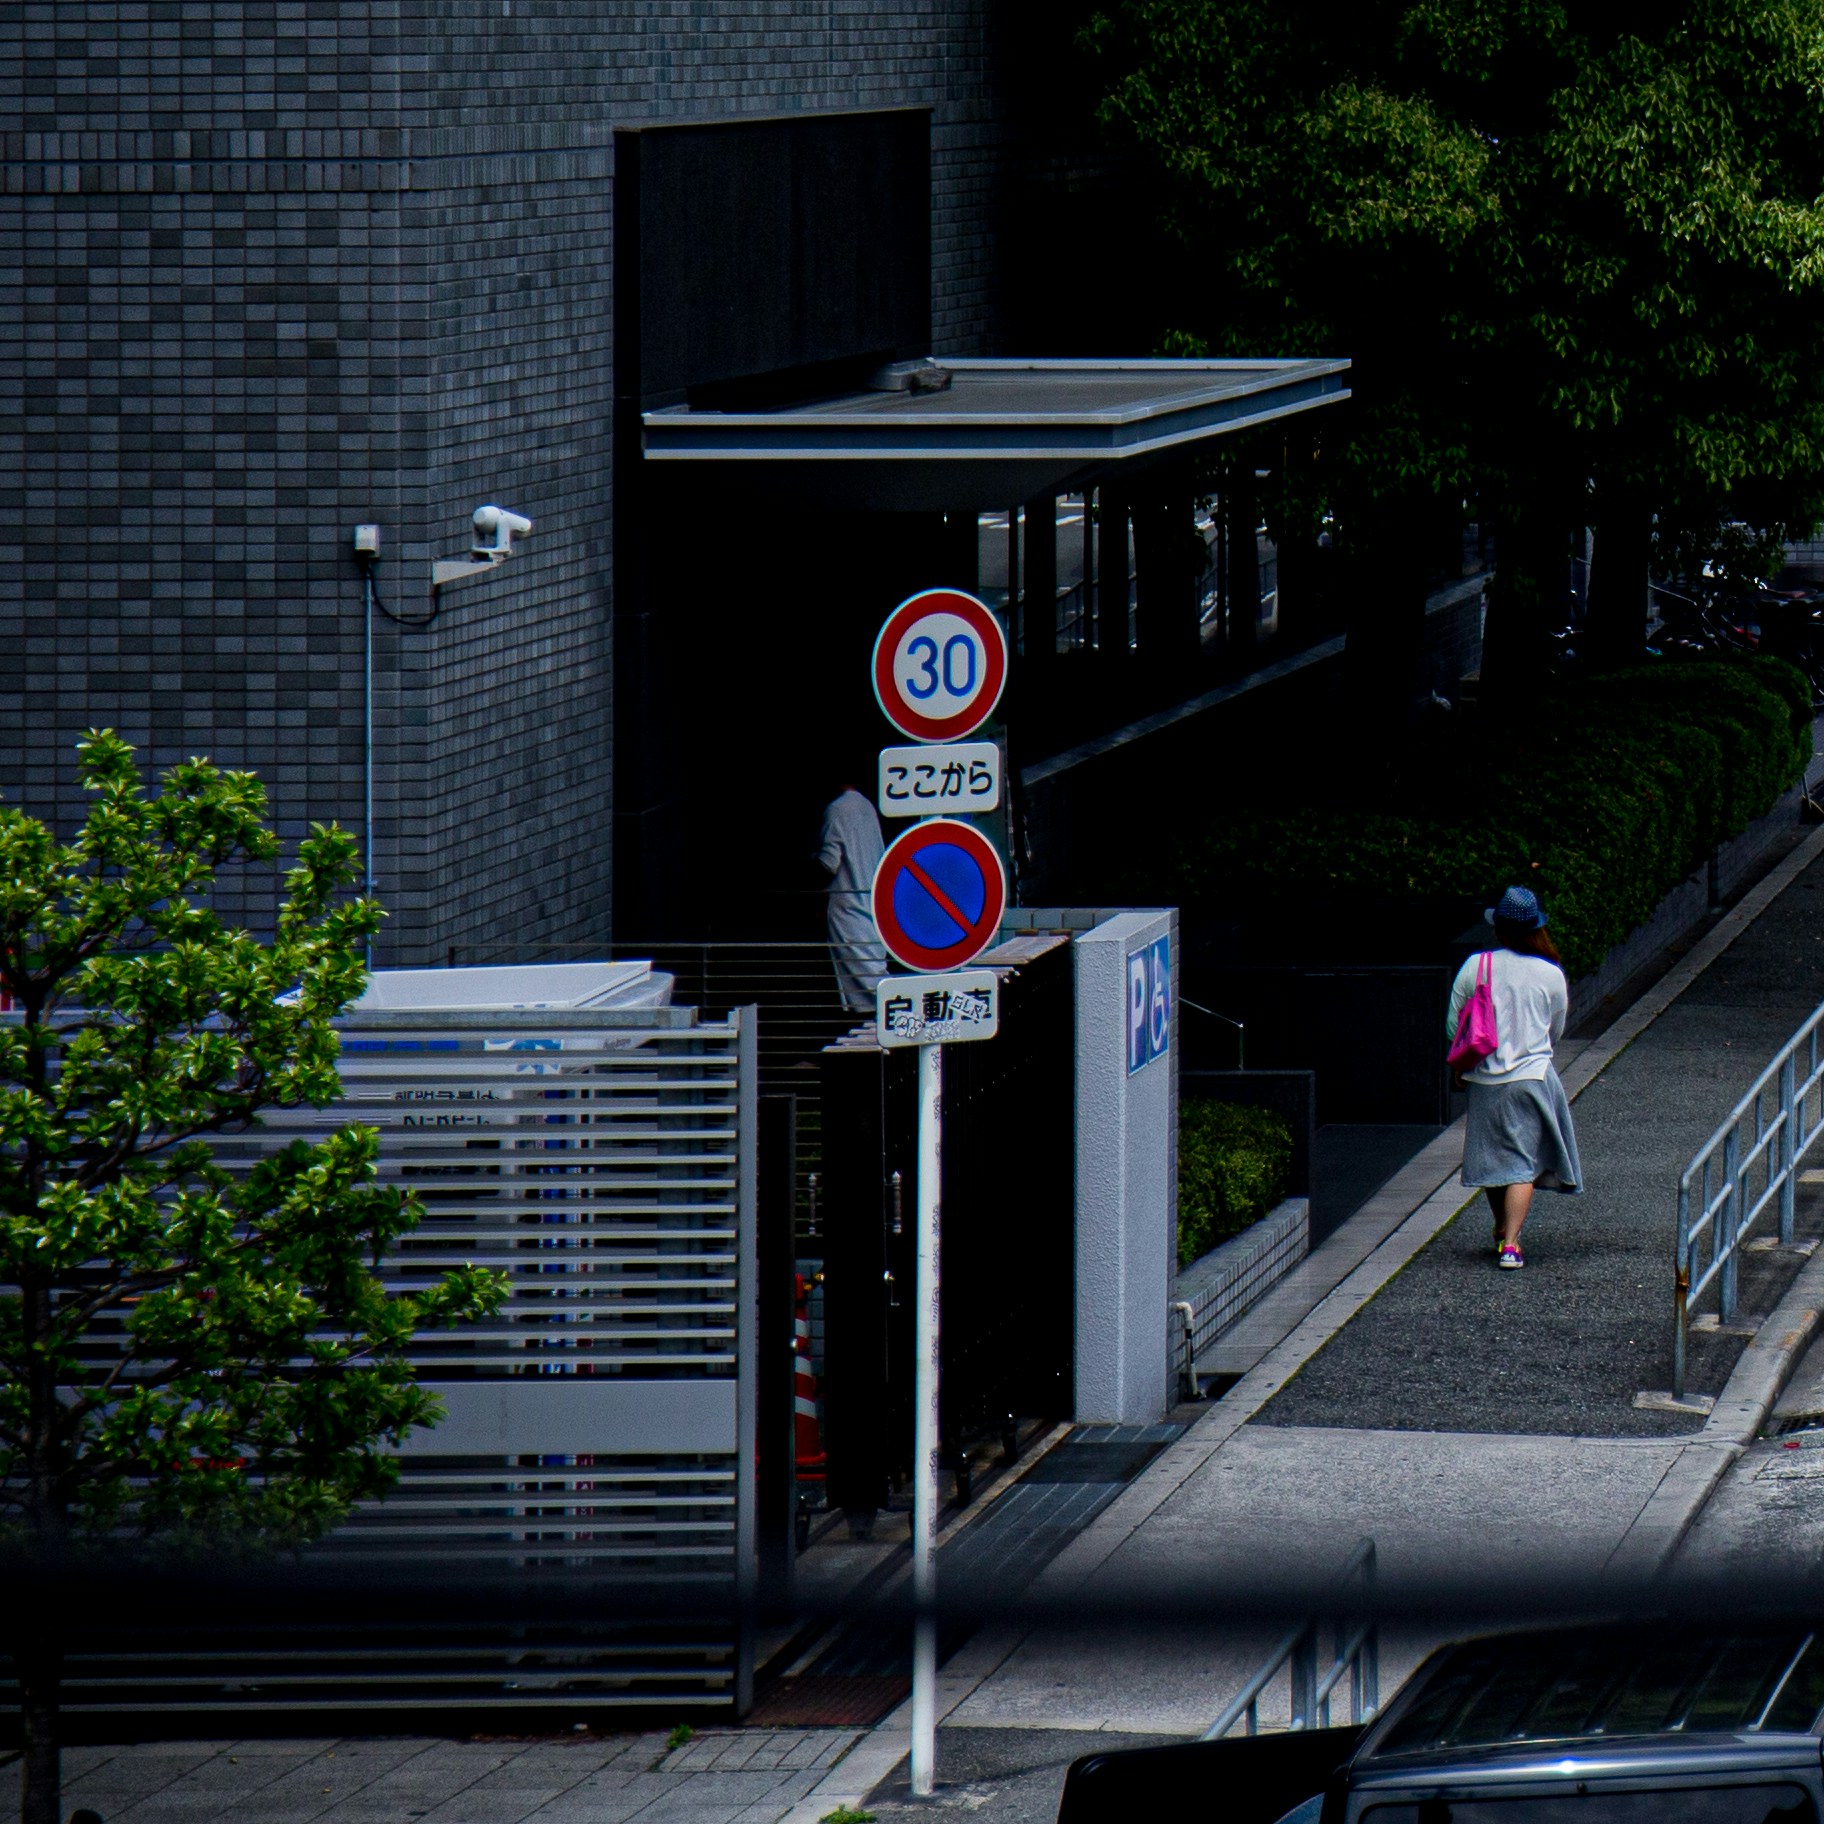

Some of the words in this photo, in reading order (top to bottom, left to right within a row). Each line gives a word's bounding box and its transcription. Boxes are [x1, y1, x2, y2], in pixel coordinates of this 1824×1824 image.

[904, 633, 978, 700] 30
[883, 759, 994, 799] ここから
[1129, 956, 1146, 1064] P
